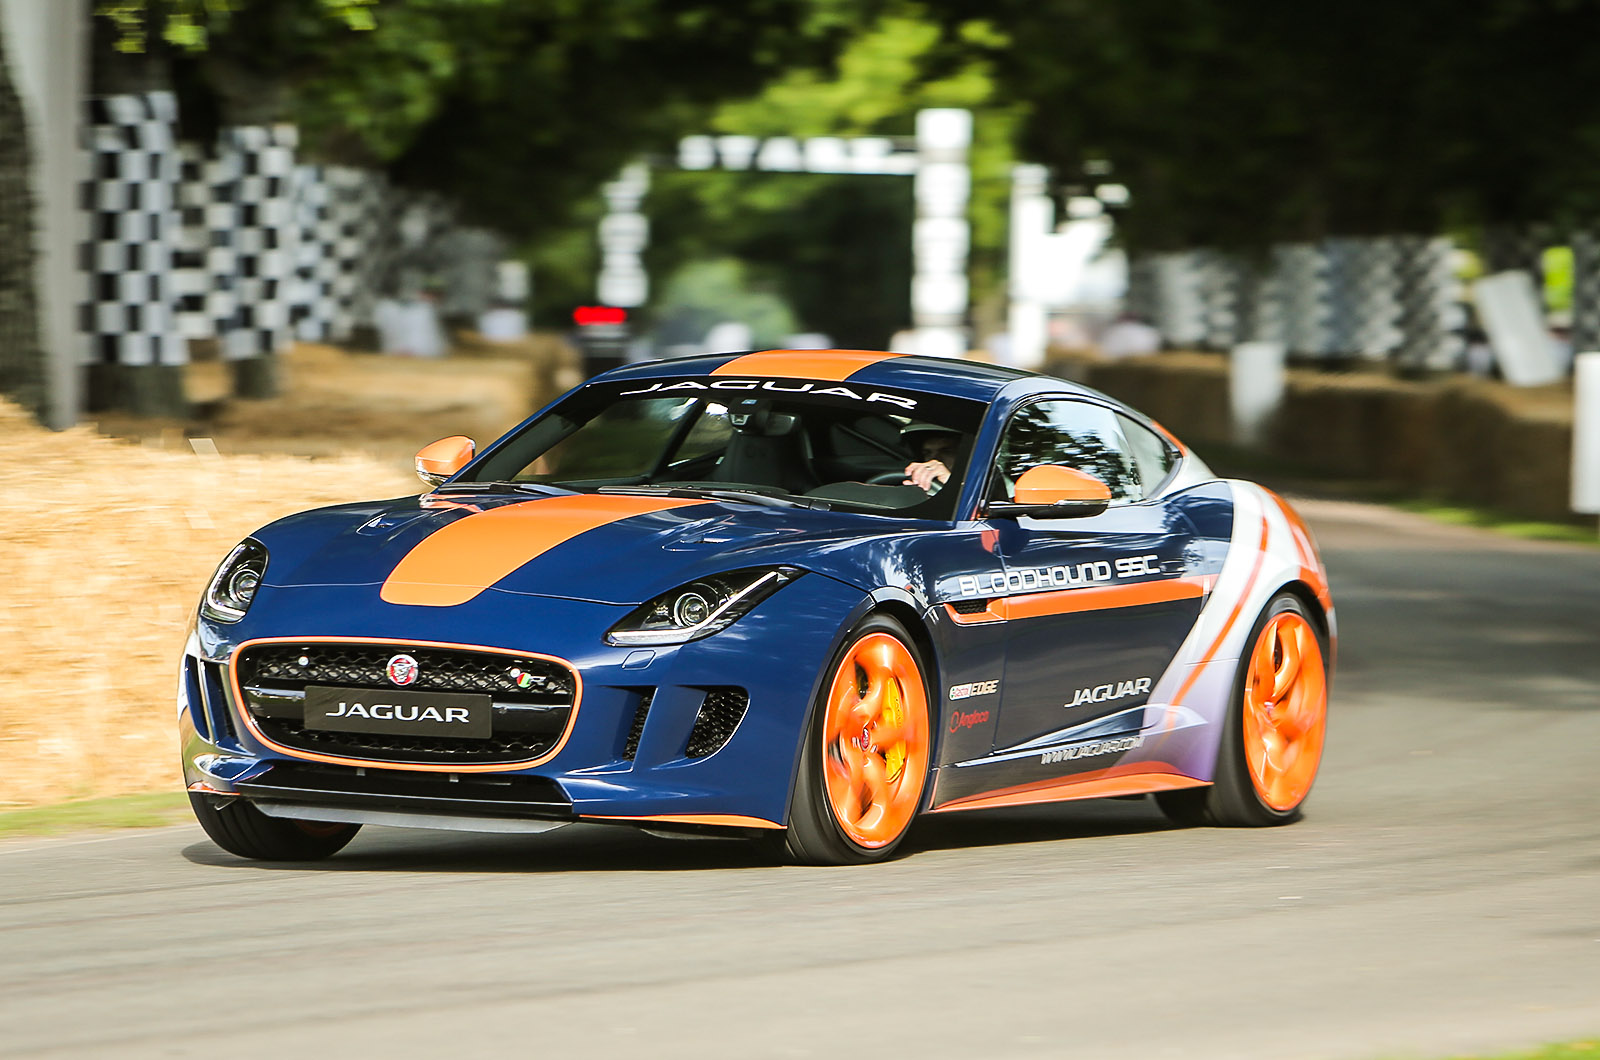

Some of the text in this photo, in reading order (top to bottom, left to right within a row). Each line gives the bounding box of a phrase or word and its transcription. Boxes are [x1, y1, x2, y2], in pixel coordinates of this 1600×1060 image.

[620, 380, 918, 410] JAGUAR
[959, 554, 1161, 596] BLOODHOUND SSC
[1064, 677, 1152, 708] JAGUAR
[325, 702, 470, 724] JAGUAR
